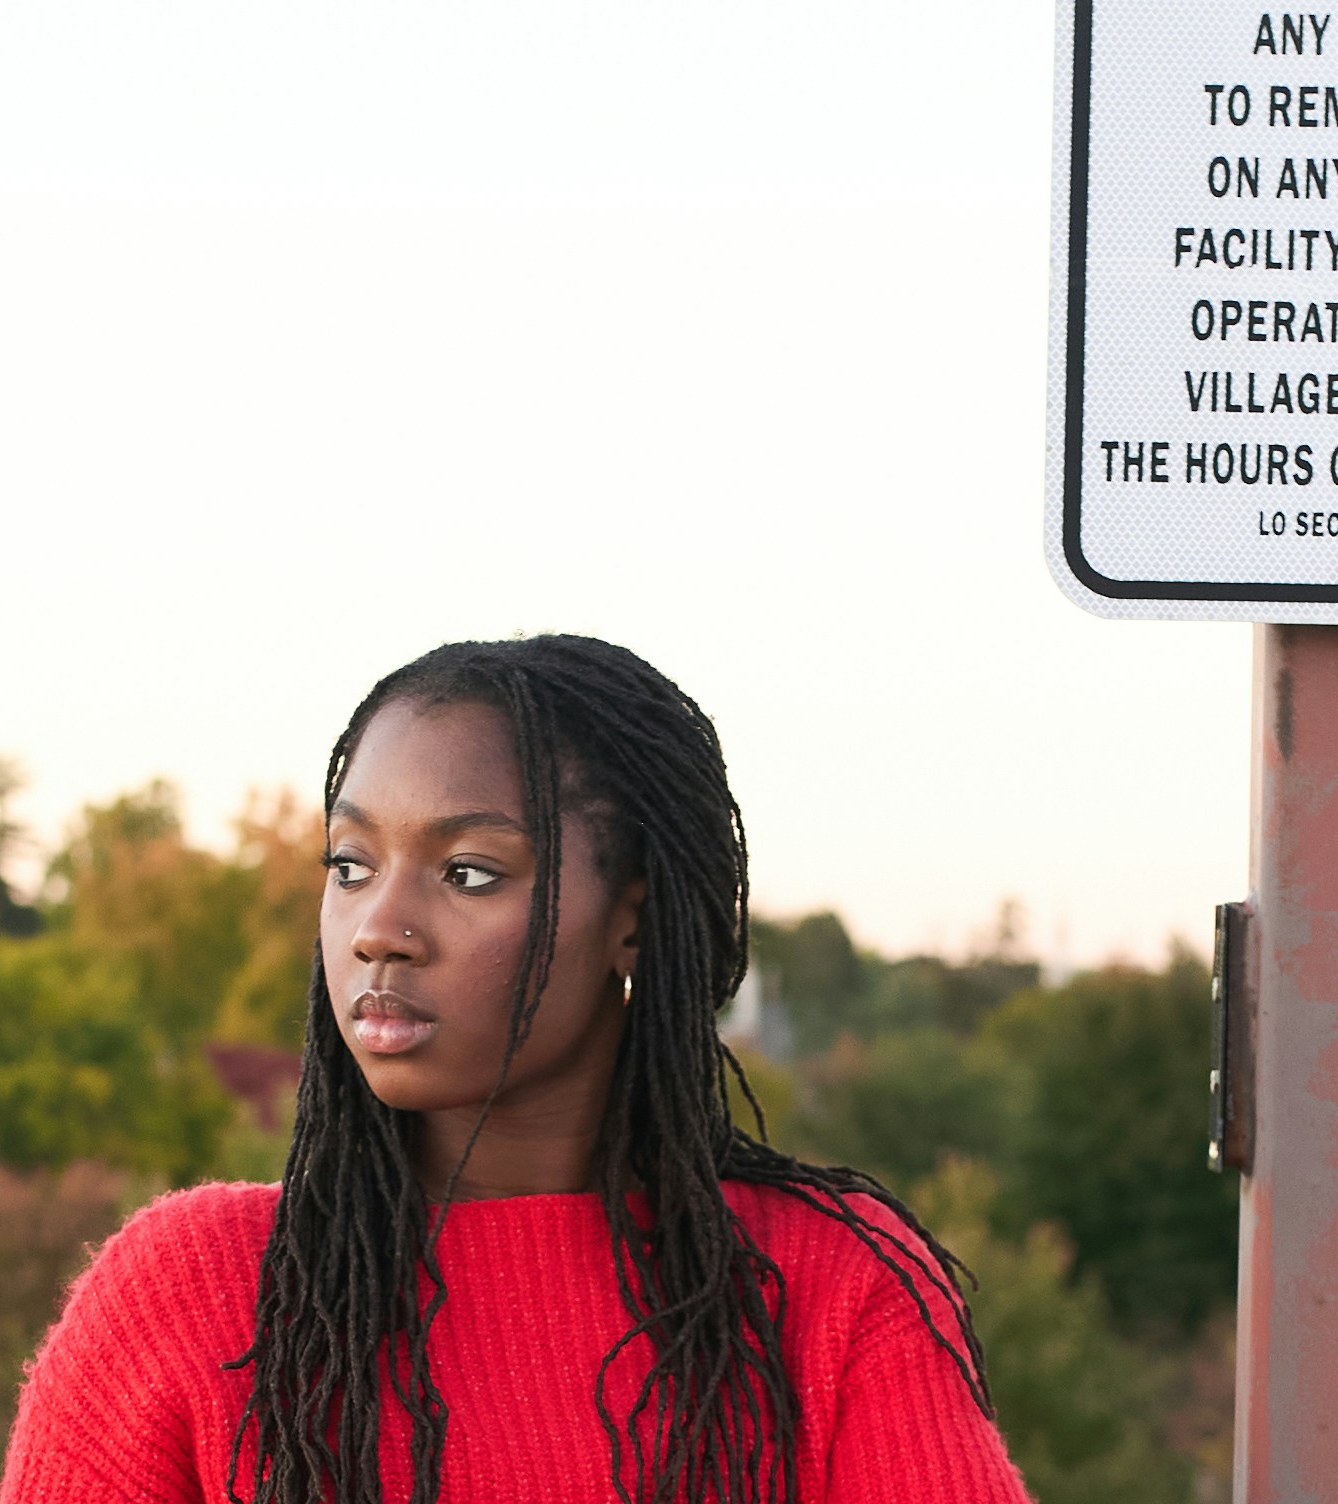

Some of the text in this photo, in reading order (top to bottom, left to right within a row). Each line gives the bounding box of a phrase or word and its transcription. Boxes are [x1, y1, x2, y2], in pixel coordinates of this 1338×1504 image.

[1252, 13, 1331, 56] ANY
[1204, 84, 1251, 127] TO
[1207, 155, 1260, 199] ON
[1100, 440, 1170, 483] THE
[1185, 442, 1314, 486] HOURS
[1259, 510, 1286, 536] LO
